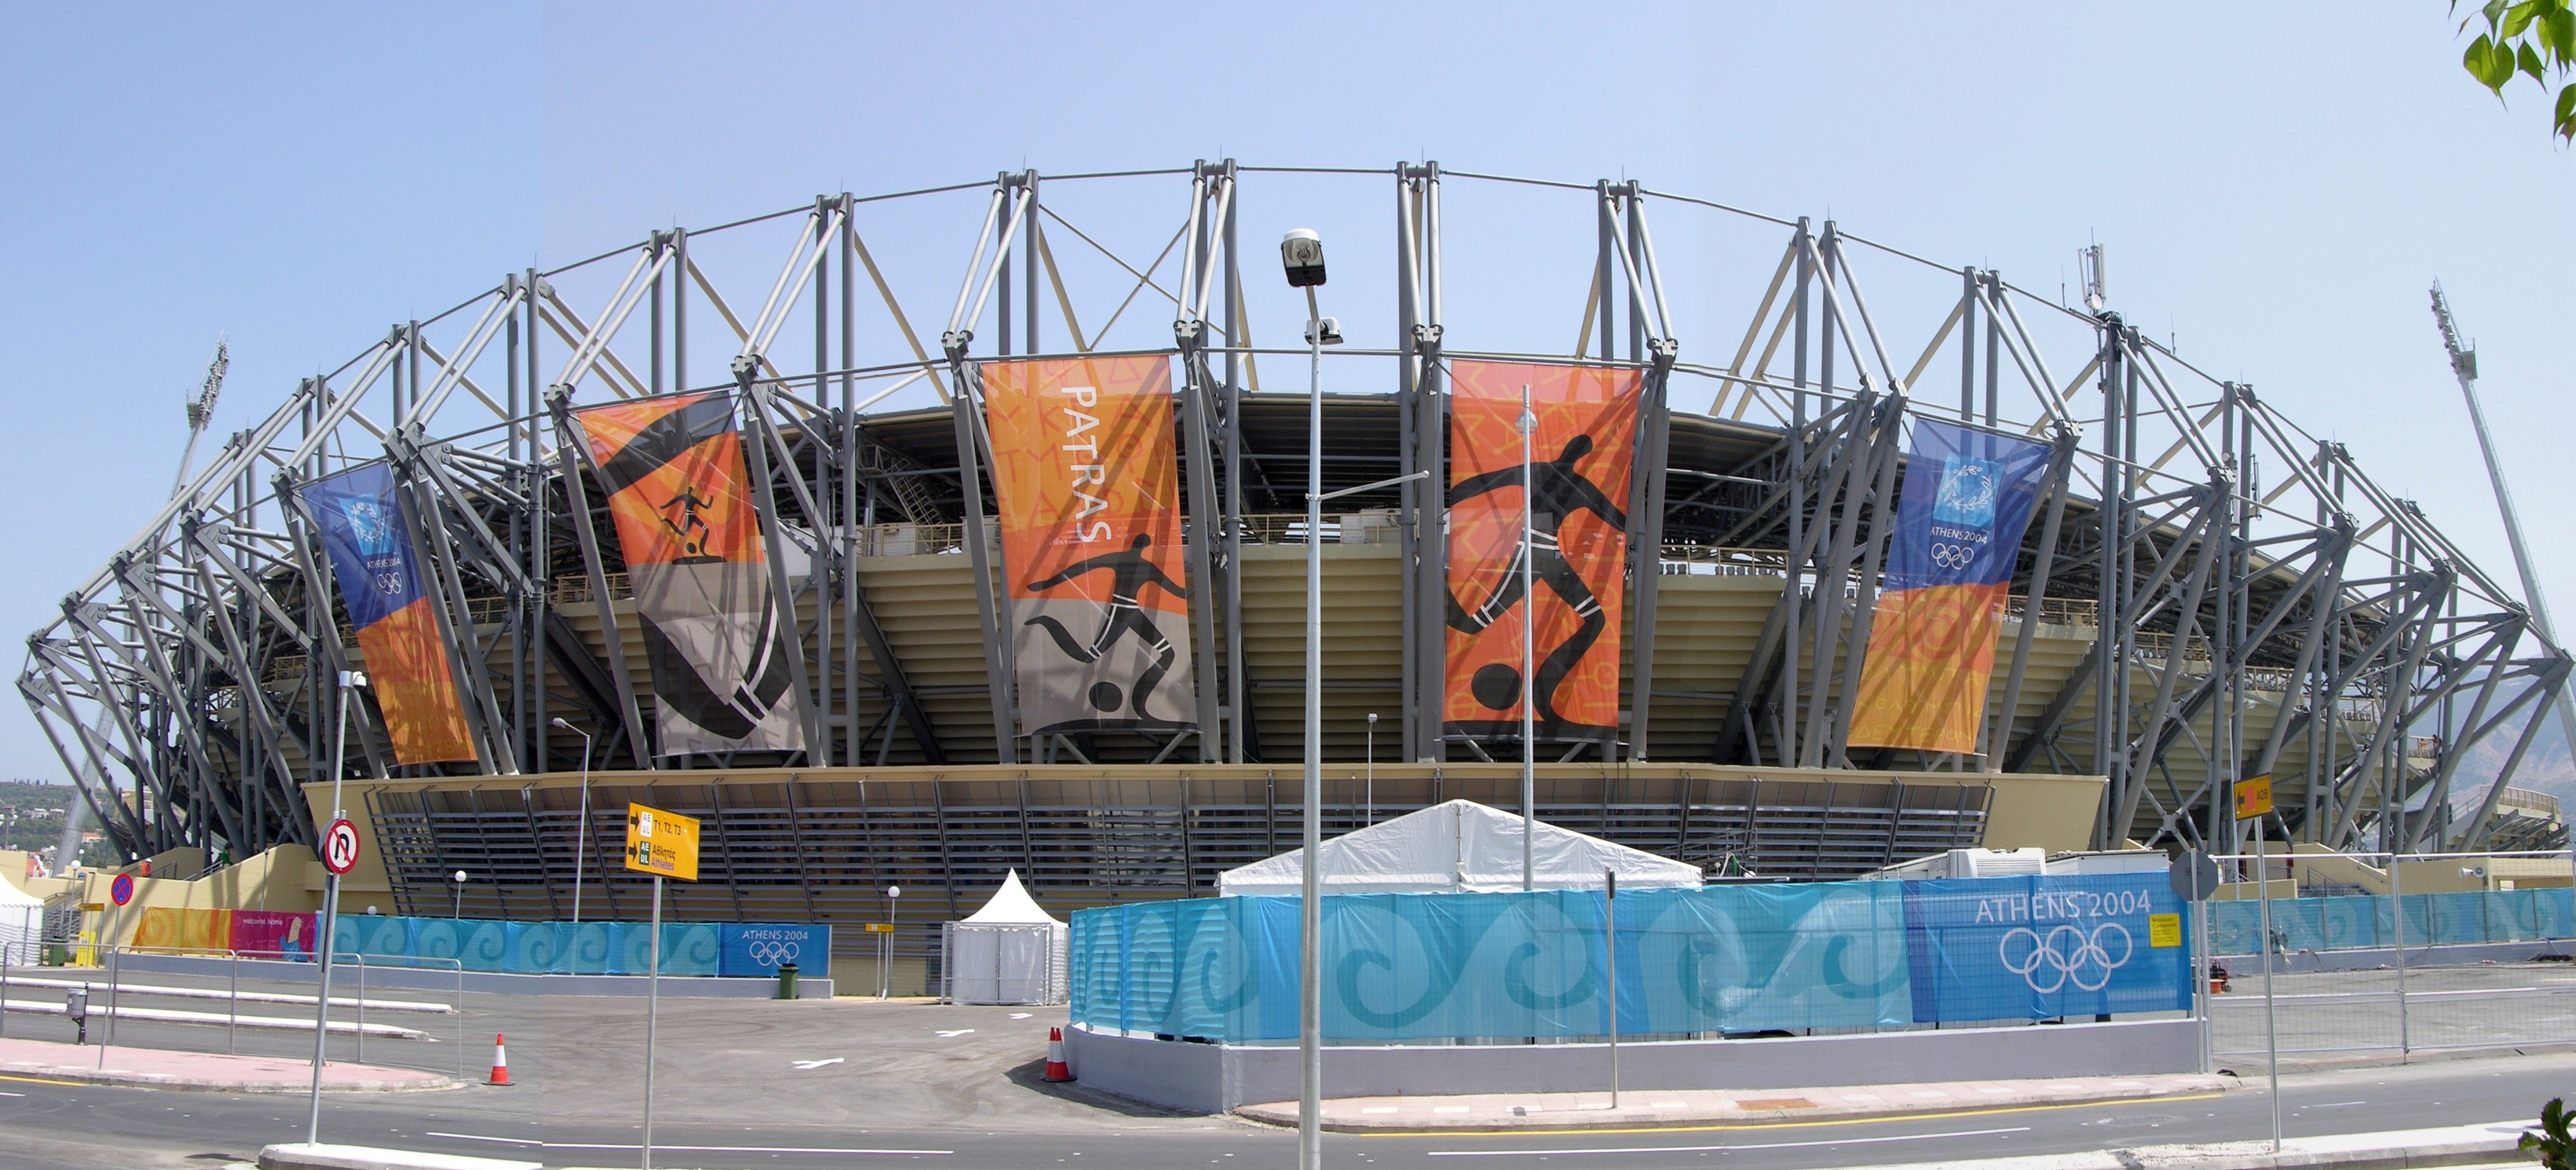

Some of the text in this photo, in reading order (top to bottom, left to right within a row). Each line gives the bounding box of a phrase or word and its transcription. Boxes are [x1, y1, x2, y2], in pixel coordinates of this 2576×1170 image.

[1061, 386, 1112, 542] PATRAS
[1929, 526, 1987, 544] ATHENS 2004
[654, 819, 681, 836] T1, T2, T3
[651, 857, 674, 871] Athletes
[1976, 889, 2151, 923] ATHENS 2004
[742, 930, 808, 940] ATHENS 2004
